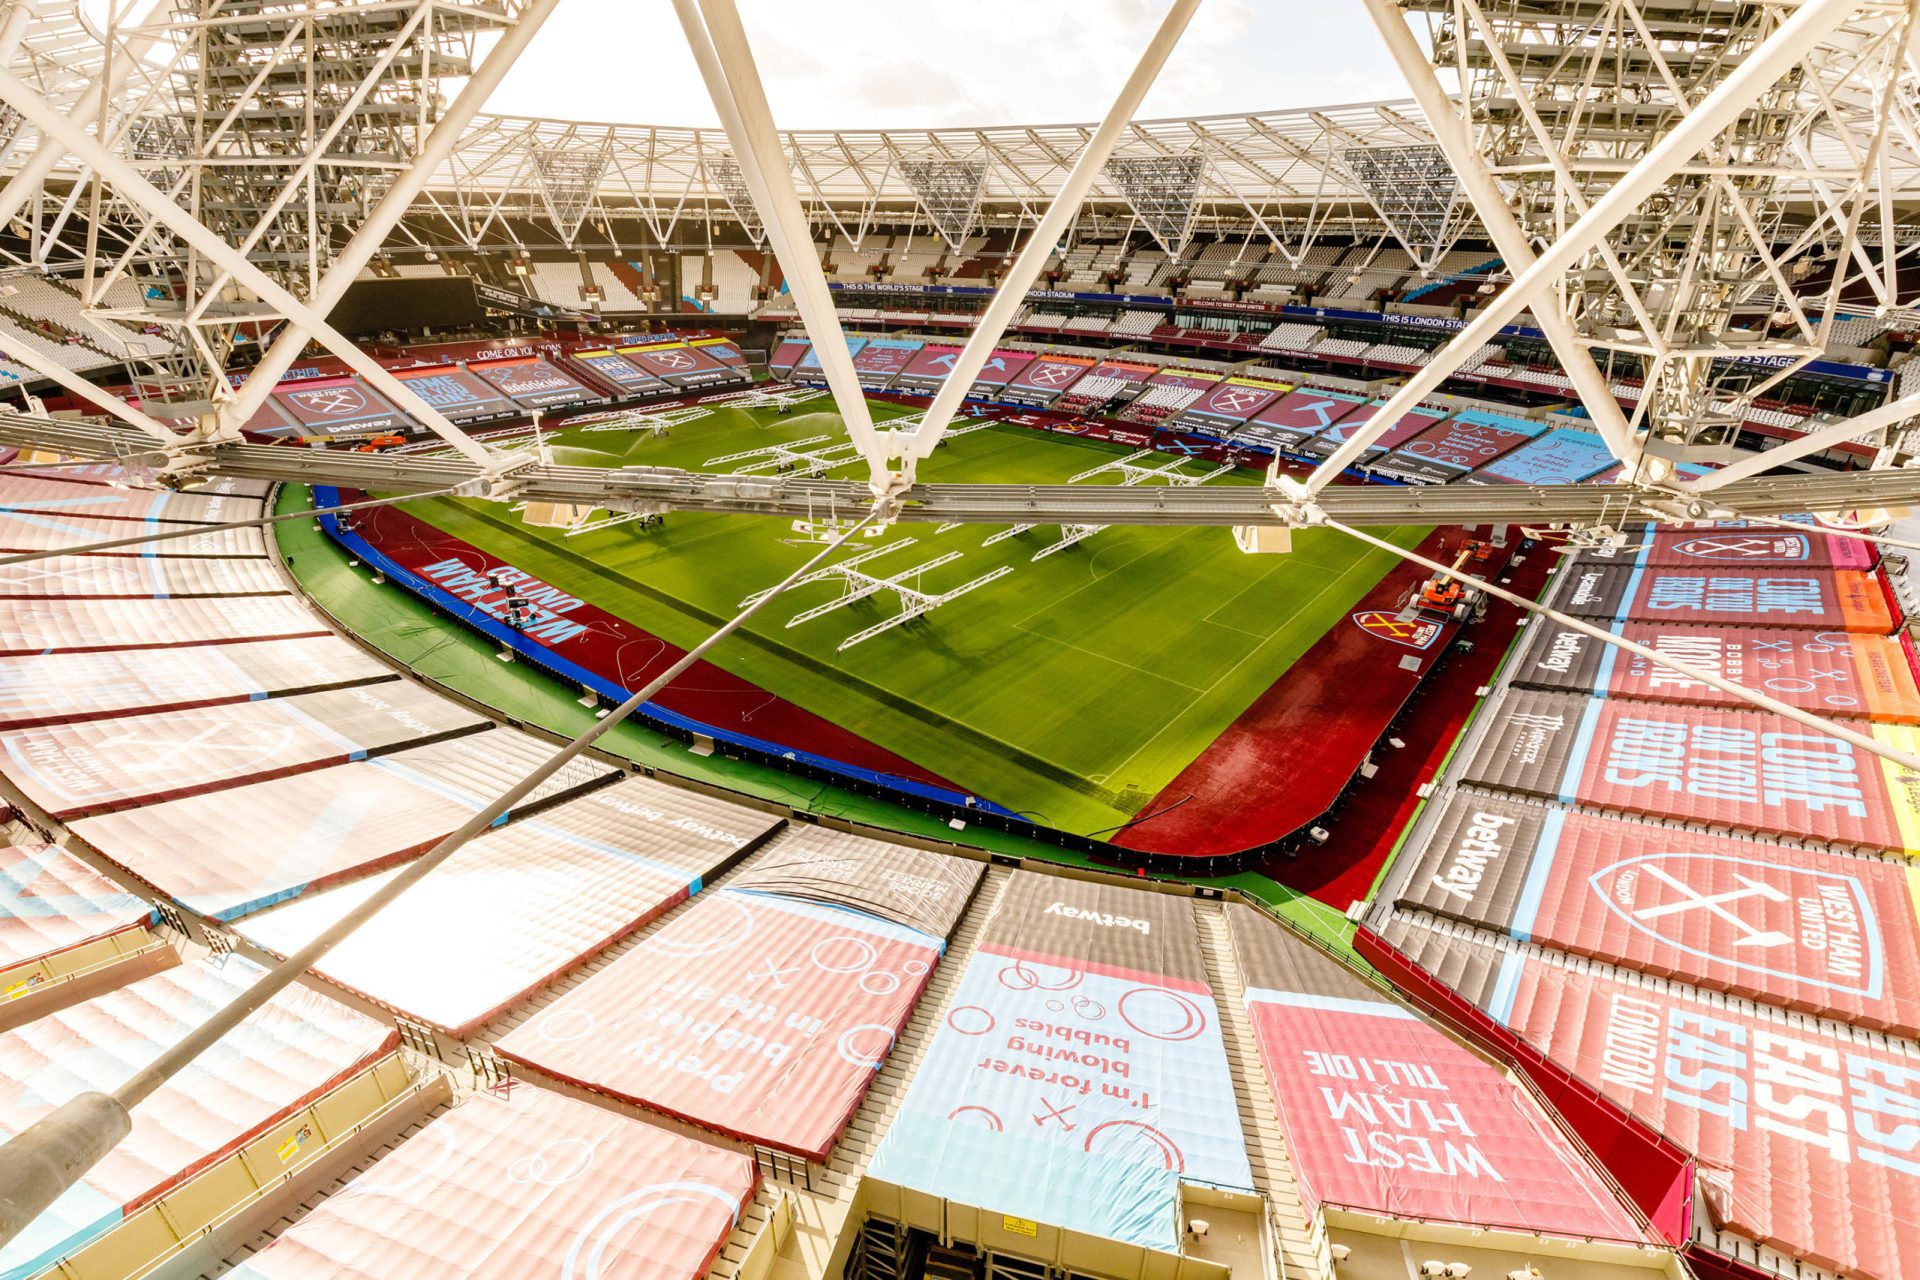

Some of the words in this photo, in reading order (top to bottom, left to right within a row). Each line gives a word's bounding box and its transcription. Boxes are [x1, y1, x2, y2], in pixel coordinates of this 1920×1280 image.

[877, 284, 904, 292] WORLD'S
[1047, 291, 1075, 299] STADIUM
[1382, 314, 1400, 322] THIS
[1410, 317, 1444, 327] LONDON
[477, 349, 502, 360] COME
[504, 347, 518, 356] ON
[1755, 355, 1796, 367] STAGE
[1466, 374, 1488, 382] Winners
[968, 392, 984, 400] betway
[327, 418, 392, 433] betway
[454, 417, 473, 425] betway
[476, 413, 494, 421] betway
[497, 410, 514, 418] betway
[1197, 427, 1216, 436] betway
[1440, 441, 1475, 452] bubbles
[1446, 436, 1482, 448] blowing
[1463, 433, 1495, 445] forever
[1377, 468, 1399, 480] betway
[1402, 476, 1427, 486] betway
[1531, 456, 1569, 469] bubbles
[1647, 576, 1706, 610] IRONS
[1709, 577, 1755, 590] ON
[1757, 577, 1825, 615] COME
[1705, 592, 1755, 612] YOU
[1537, 632, 1588, 673] betway
[1630, 639, 1651, 677] SAND
[1650, 635, 1722, 692] MOORE
[1726, 643, 1743, 684] BOBBY
[1604, 717, 1690, 793] IRONS
[1690, 725, 1757, 754] ON
[1686, 757, 1759, 804] YOU
[1760, 732, 1868, 818] COME
[592, 791, 664, 824] betway
[669, 816, 754, 848] betway
[1432, 812, 1516, 902] betway
[1614, 869, 1639, 906] LONDON
[1042, 902, 1150, 935] betway
[1797, 897, 1828, 952] UNITED
[1819, 884, 1858, 935] WEST
[1827, 933, 1863, 979] HAM
[658, 977, 716, 1001] air
[720, 990, 778, 1024] the
[640, 1004, 792, 1068] bubbles
[784, 1012, 823, 1040] in
[1014, 1017, 1130, 1054] bubbles
[1006, 1035, 1130, 1079] blowing
[1599, 992, 1662, 1094] LONDON
[622, 1036, 747, 1095] Pretty
[978, 1057, 1092, 1096] forever
[1302, 1050, 1359, 1079] DIE
[1359, 1056, 1376, 1081] I
[1374, 1058, 1450, 1092] TILL
[1662, 1006, 1748, 1132] EAST
[1102, 1083, 1150, 1109] I'm
[1318, 1086, 1479, 1138] HAM
[1752, 1028, 1852, 1163] EAST
[1845, 1051, 1920, 1177] EAST
[1341, 1126, 1508, 1183] WEST
